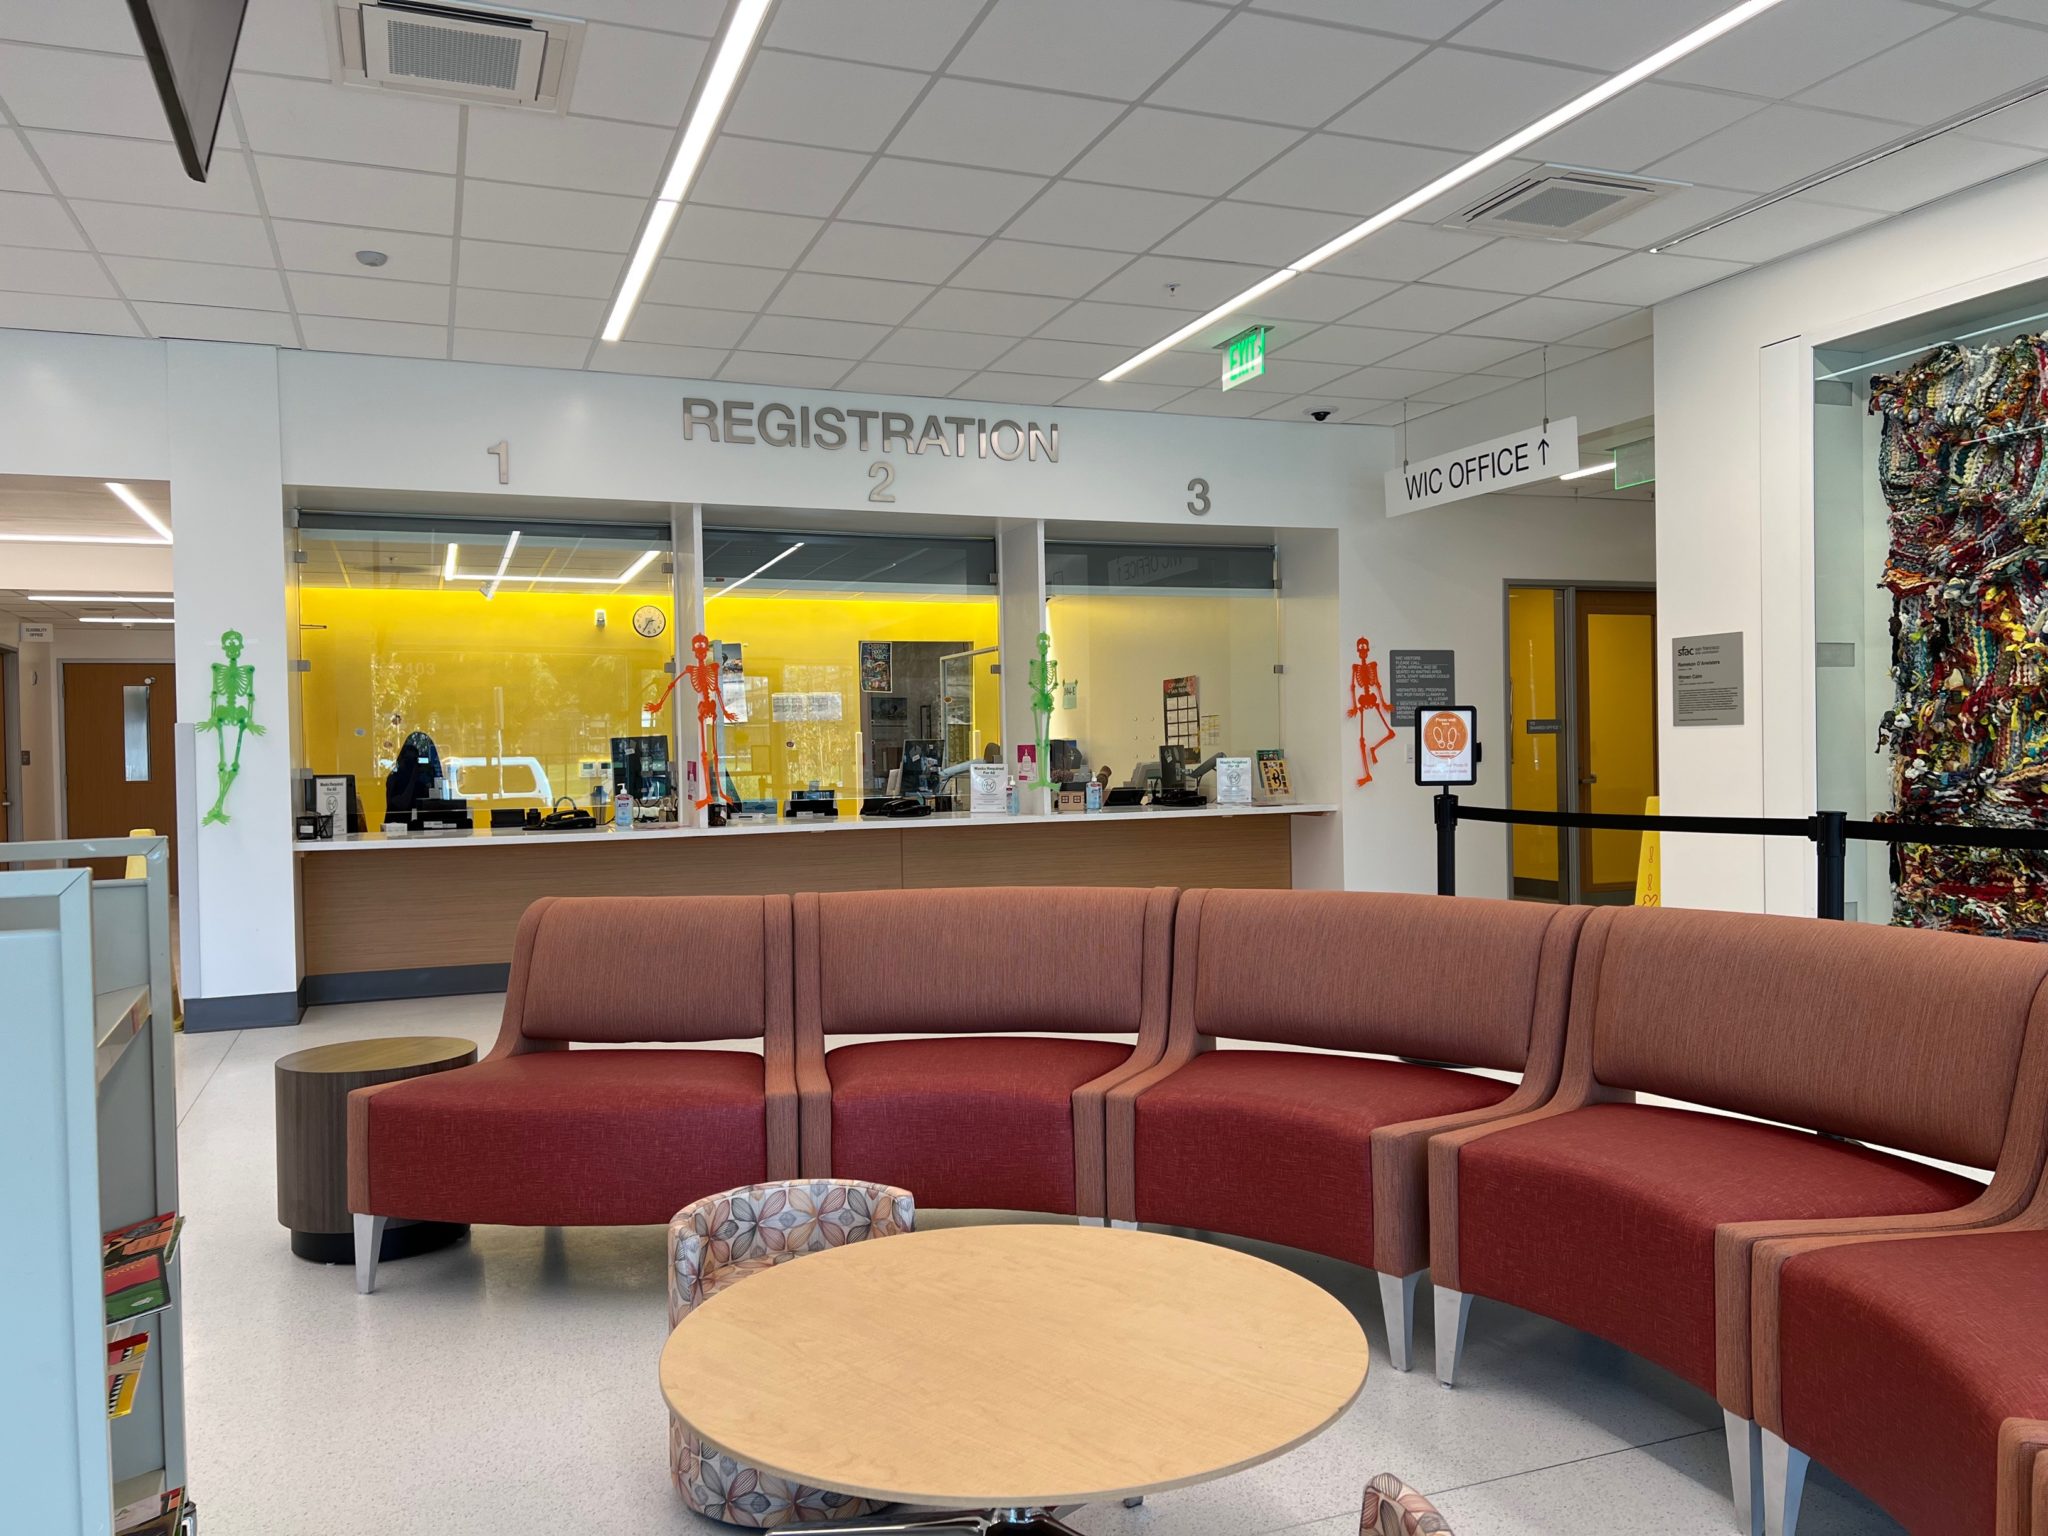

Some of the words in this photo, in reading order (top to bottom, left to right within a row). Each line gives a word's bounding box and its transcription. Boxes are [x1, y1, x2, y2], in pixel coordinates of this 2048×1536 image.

[682, 397, 1060, 463] REGISTRATION
[487, 440, 509, 485] 1
[868, 461, 896, 503] 2
[1405, 467, 1443, 500] WIC
[1448, 443, 1530, 489] OFFICE
[1187, 478, 1211, 516] 3
[1678, 646, 1695, 657] sfac
